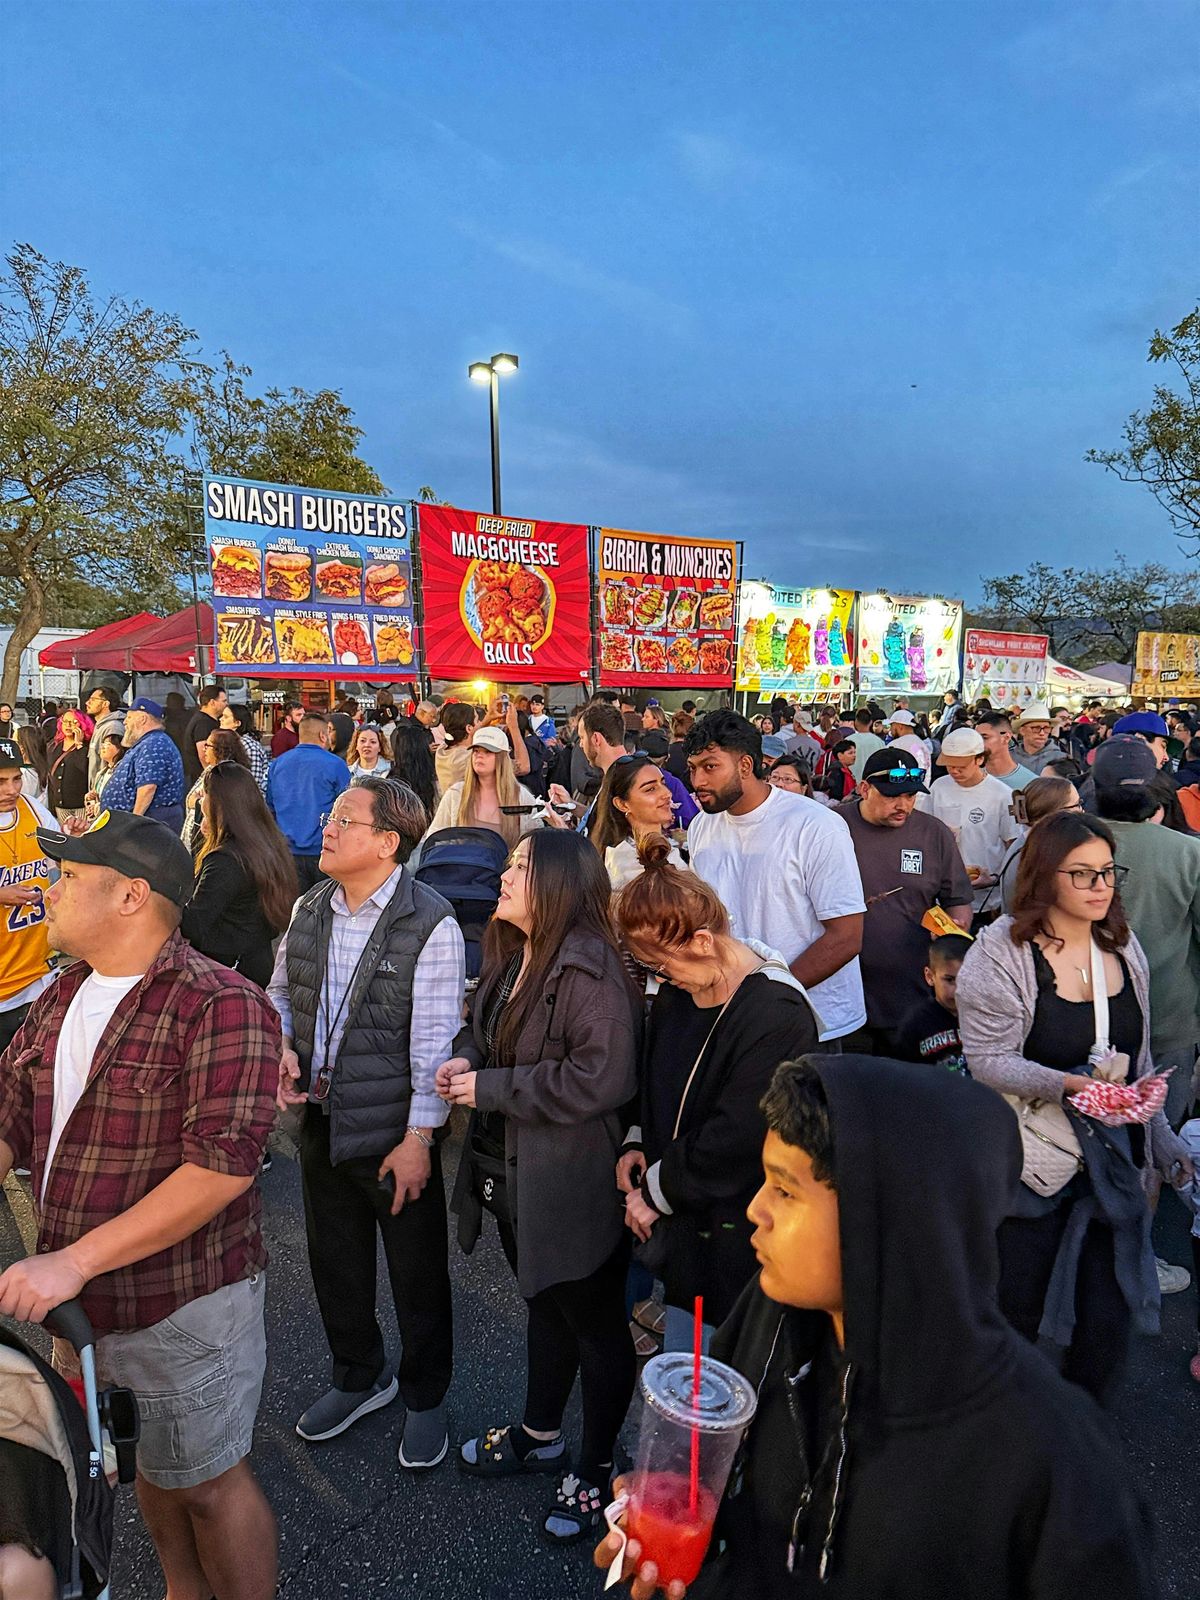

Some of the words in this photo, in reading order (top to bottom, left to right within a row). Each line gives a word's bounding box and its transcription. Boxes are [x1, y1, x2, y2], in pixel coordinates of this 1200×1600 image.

[208, 482, 295, 529] SMASH
[301, 495, 407, 538] BURGERS
[478, 517, 504, 535] DEEP
[504, 521, 532, 538] FRIED
[211, 535, 233, 545] SMASH
[233, 538, 257, 548] BURGER
[277, 537, 297, 546] DONUT
[325, 542, 350, 550] EXTREME
[266, 542, 288, 551] SMASH
[288, 545, 309, 554] BURGER
[316, 548, 340, 557] CHICKEN
[340, 550, 361, 558] BURGER
[366, 545, 384, 554] DONUT
[384, 546, 406, 555] CHICKEN
[451, 531, 560, 566] MAC&CHEESE
[603, 537, 649, 574] BIRRIA
[651, 543, 662, 575] &
[664, 544, 732, 580] MUNCHIES
[225, 605, 245, 614] SMASH
[245, 607, 261, 615] FRIES
[274, 608, 295, 618] ANIMAL
[295, 610, 312, 619] STYLE
[312, 611, 328, 619] FRIES
[331, 612, 349, 620] WINGS
[373, 614, 388, 622] FRIED
[483, 642, 536, 665] BALLS
[903, 860, 920, 873] OBEY
[920, 1029, 957, 1056] GRAVE
